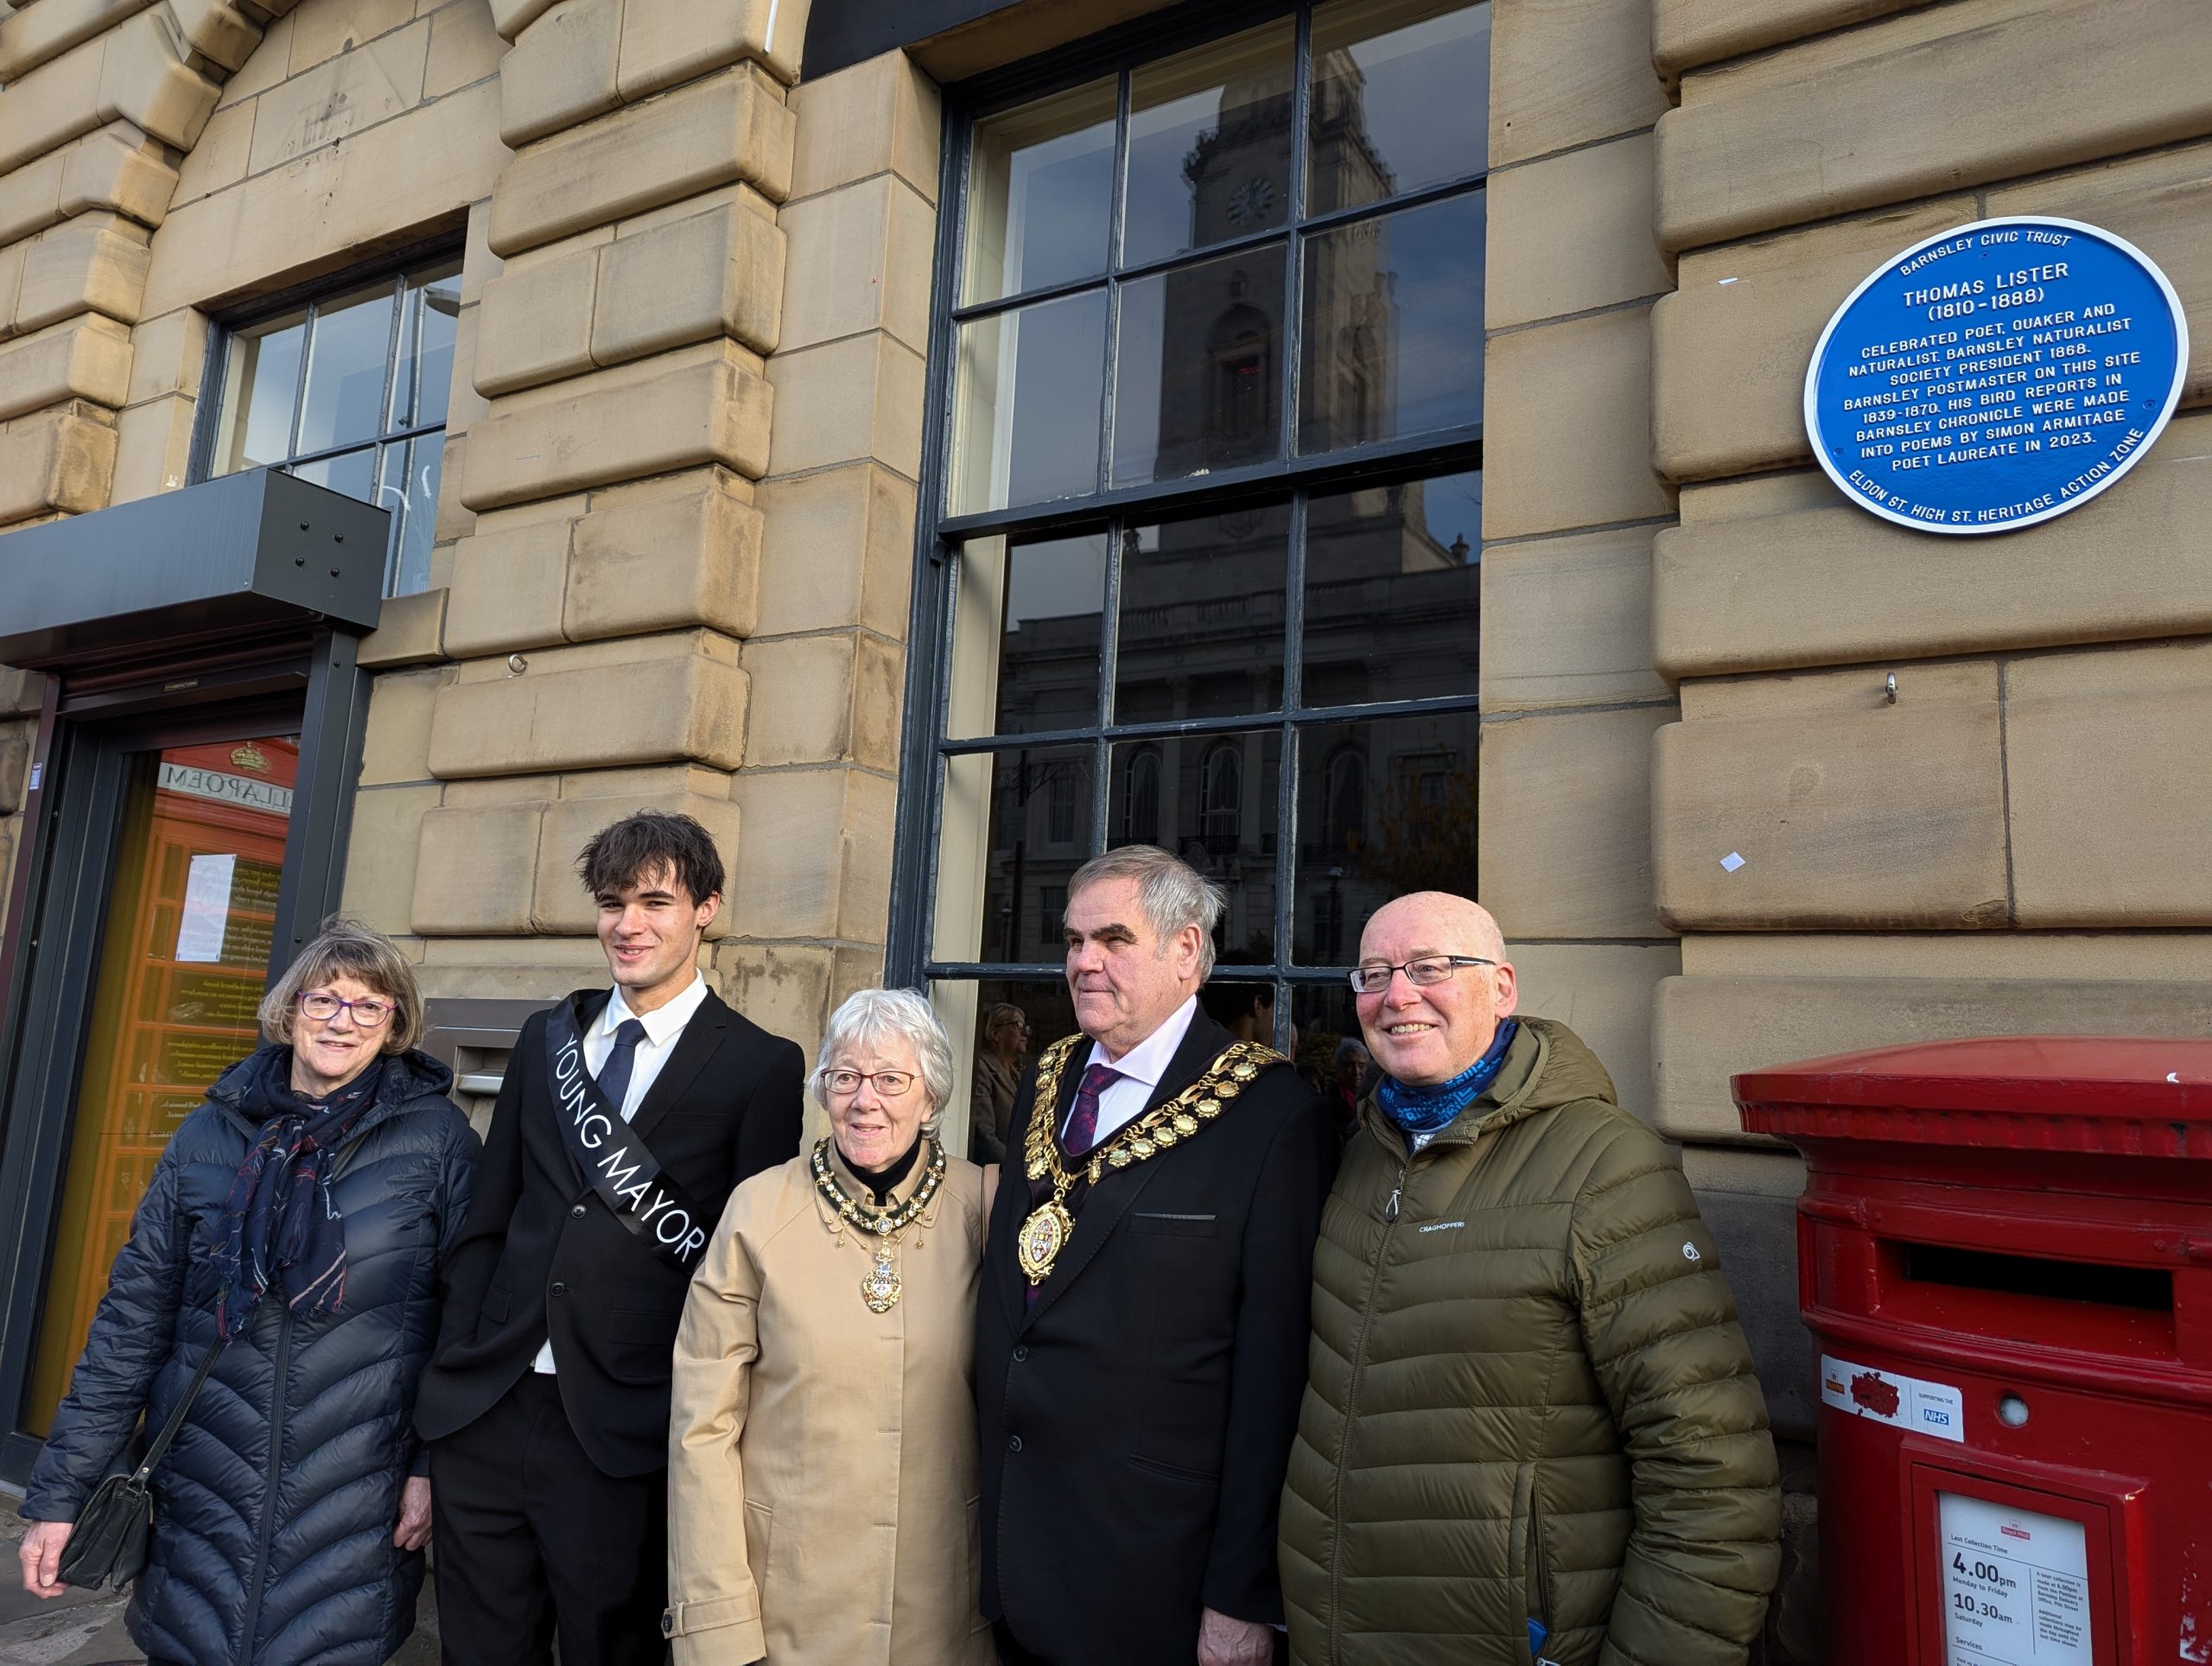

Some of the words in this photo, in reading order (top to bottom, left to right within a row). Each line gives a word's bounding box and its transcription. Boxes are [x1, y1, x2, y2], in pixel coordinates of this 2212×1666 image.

[1900, 238, 1973, 276] BARNSLEY
[1981, 232, 2018, 245] CIVIC
[2027, 231, 2071, 246] TRUST
[1904, 280, 1984, 306] THOMAS
[1997, 263, 2068, 288] LISTER
[1862, 332, 1957, 358] CELEBRATED
[2013, 311, 2074, 330] QUAKER
[2083, 303, 2114, 318] AND
[1947, 336, 2024, 359] BARNSLEY
[2033, 318, 2131, 344] NATURALIST
[1845, 389, 1918, 410] BARNSLEY
[1928, 372, 2026, 397] POSTMASTER
[2035, 366, 2055, 378] ON
[2063, 359, 2096, 374] THIS
[2105, 352, 2140, 366] SITE
[1891, 366, 1951, 385] SOCIETY
[1960, 350, 2042, 374] PRESIDENT
[1948, 397, 1971, 410] HIS
[1980, 391, 2015, 404] BIRD
[2025, 378, 2096, 397] REPORTS
[2107, 373, 2121, 385] IN
[1857, 421, 1931, 442] BARNSLEY
[1939, 406, 2022, 429] CHRONICLE
[2032, 398, 2075, 414] WERE
[2084, 391, 2129, 406] MADE
[1862, 444, 1893, 458] INTO
[1902, 436, 1951, 452] POEMS
[1961, 431, 1978, 443] BY
[1986, 423, 2034, 439] SIMON
[2043, 410, 2125, 430] ARMITAGE
[1892, 455, 1930, 471] POET
[1938, 442, 2017, 464] LAUREATE
[2025, 440, 2040, 451] IN
[1849, 470, 1888, 500] ELDON
[1911, 505, 1945, 520] HIGH
[1978, 493, 2054, 521] HERITAGE
[2061, 461, 2111, 498] ACTION
[2110, 429, 2143, 461] ZONE
[556, 1029, 612, 1148] YOUNG
[597, 1147, 705, 1262] MAYOR
[1419, 1222, 1465, 1233] CRAGHOPPERS
[1918, 1392, 1944, 1402] SUPPORTING
[1925, 1410, 1948, 1424] NHS
[1951, 1534, 1963, 1542] Last
[1965, 1537, 1992, 1550] Collection
[1993, 1545, 2008, 1554] Time
[1953, 1576, 1977, 1589] Monday
[1988, 1587, 2008, 1598] Friday
[1955, 1612, 1983, 1627] Saturday
[1956, 1637, 1983, 1650] Services
